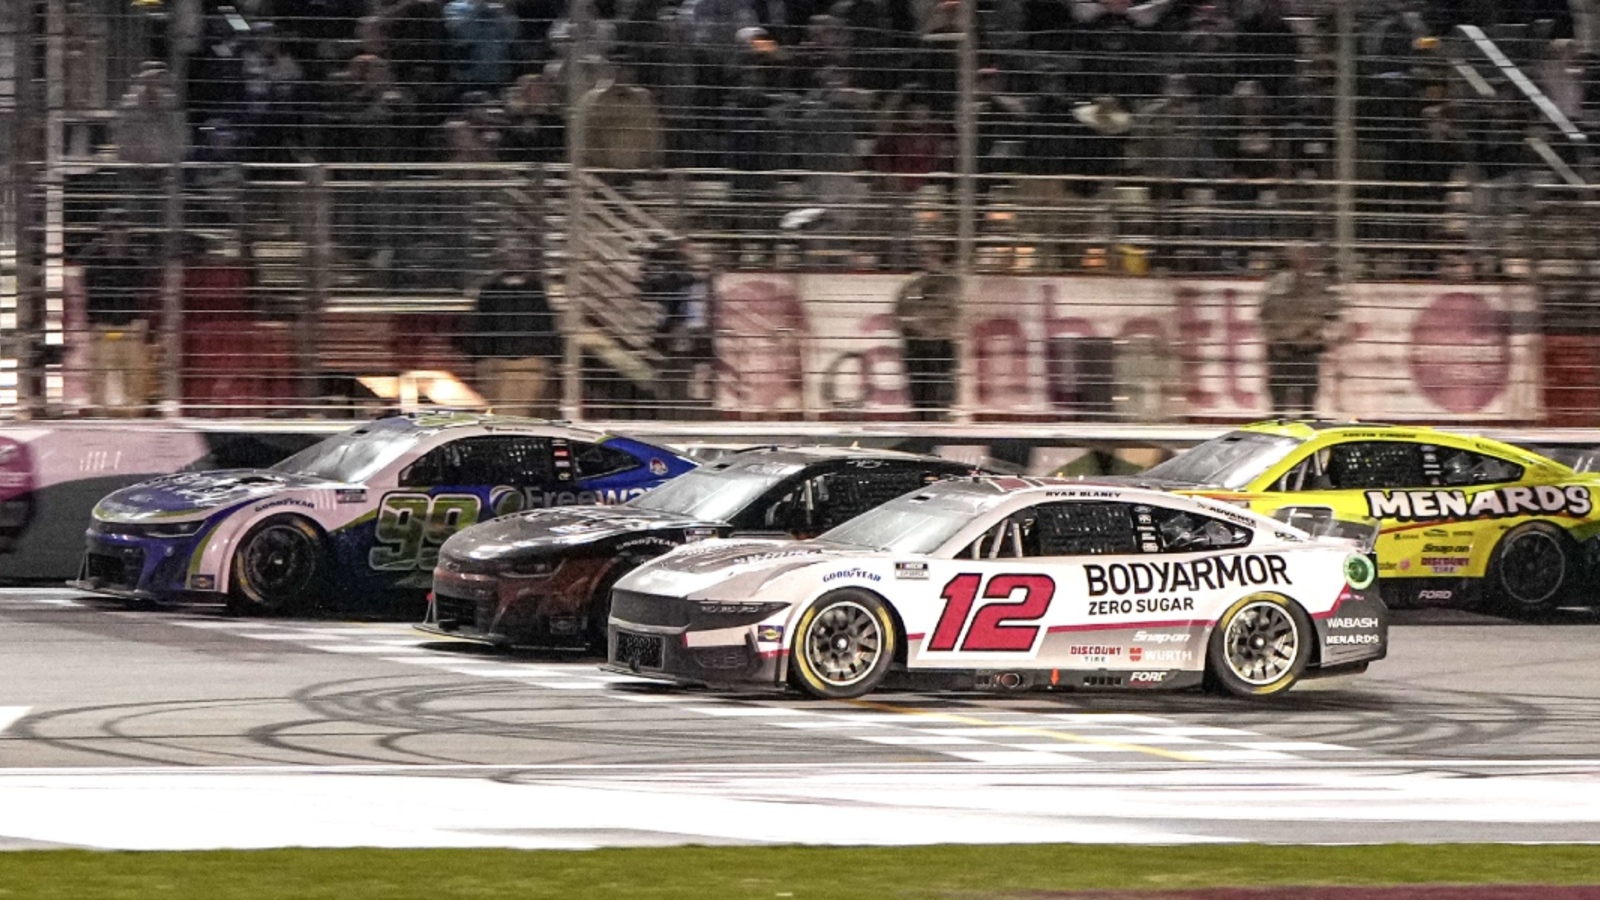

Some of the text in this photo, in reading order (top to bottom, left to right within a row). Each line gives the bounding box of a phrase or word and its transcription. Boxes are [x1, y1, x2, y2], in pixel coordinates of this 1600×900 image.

[524, 485, 664, 509] Freewa
[1045, 490, 1122, 499] RYAN BLANEY
[254, 498, 316, 512] GOODYEAR
[1365, 485, 1592, 520] MENARDS
[368, 491, 483, 571] 99
[822, 567, 882, 583] GOODYEAR
[1083, 555, 1293, 597] BODYARMOR
[1418, 590, 1453, 600] FORD
[926, 572, 1057, 652] 12
[1087, 597, 1195, 616] ZERO SUGAR
[1326, 617, 1379, 629] WABASH
[1132, 630, 1192, 644] Snap-on
[1325, 634, 1380, 646] MENARDS
[1069, 645, 1122, 656] DISCOUNT
